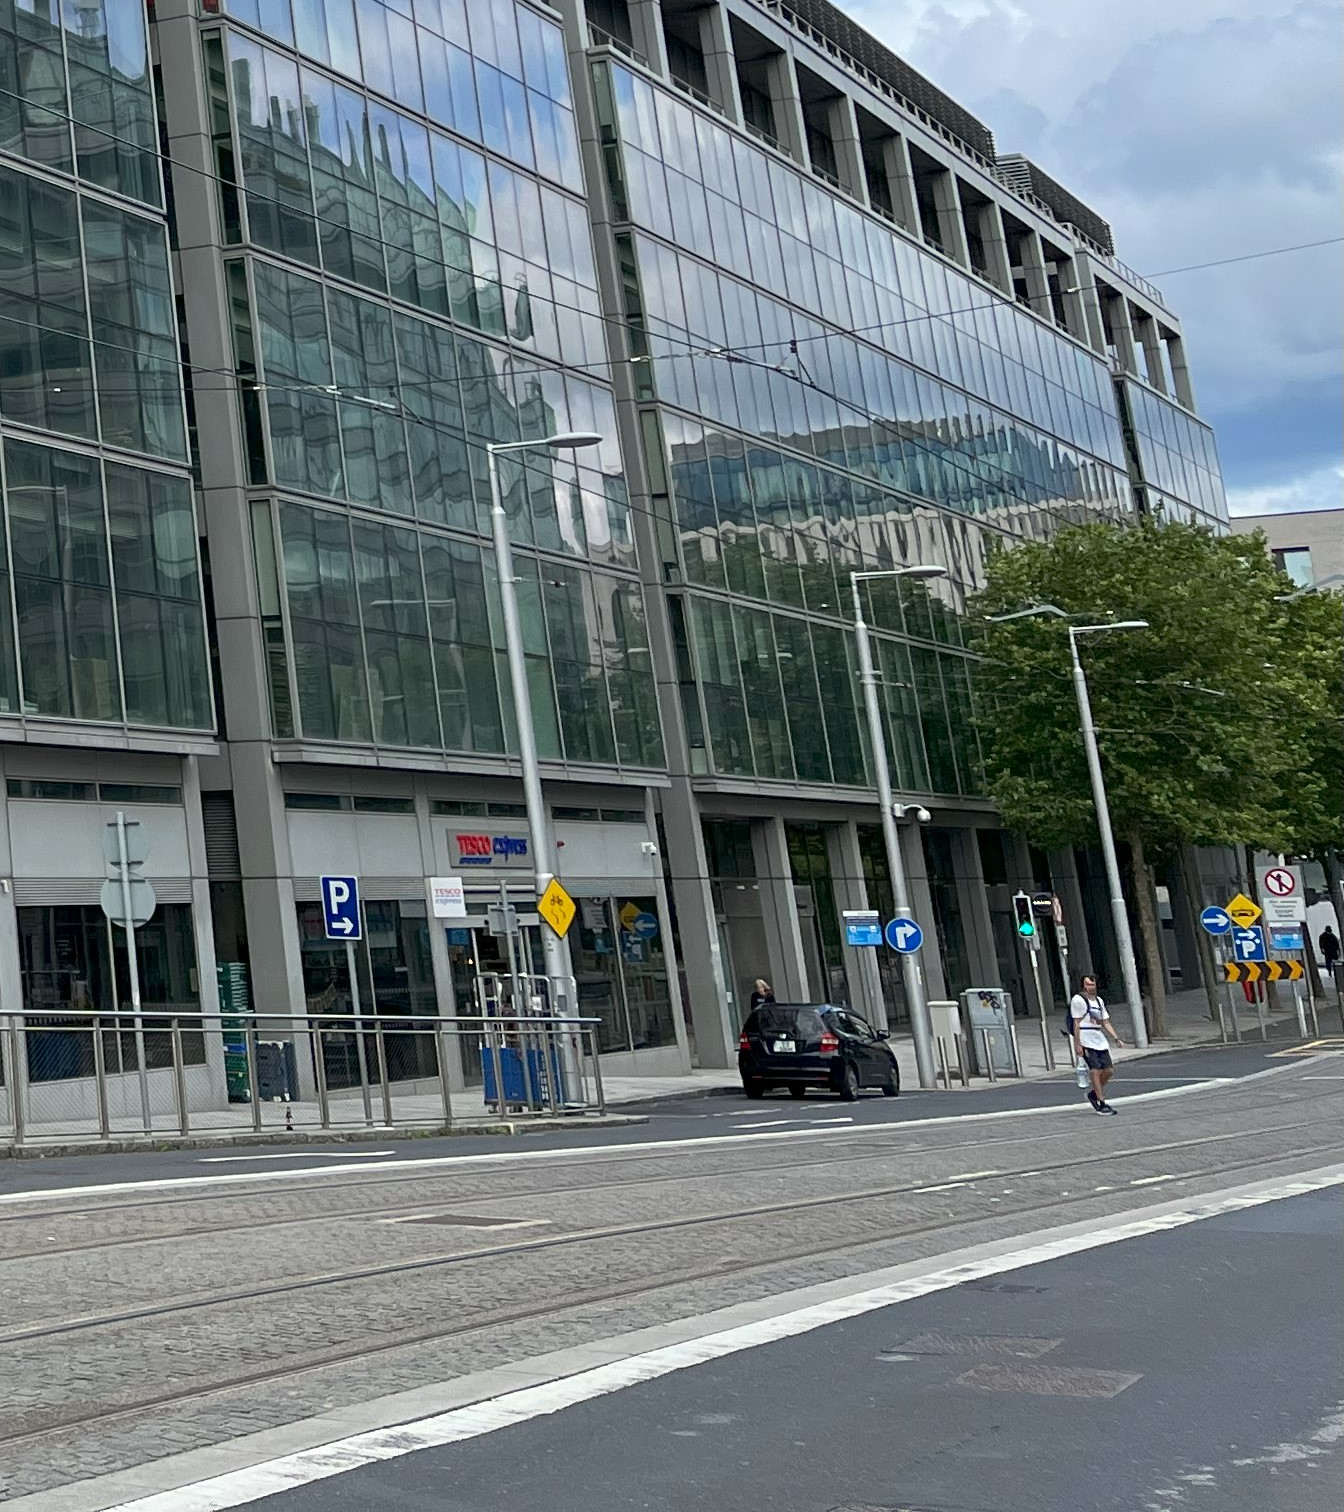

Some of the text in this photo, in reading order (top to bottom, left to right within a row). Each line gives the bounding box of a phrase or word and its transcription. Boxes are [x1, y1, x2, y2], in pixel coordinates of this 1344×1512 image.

[456, 834, 491, 856] TESCO
[328, 880, 350, 915] P
[1241, 940, 1256, 959] P
